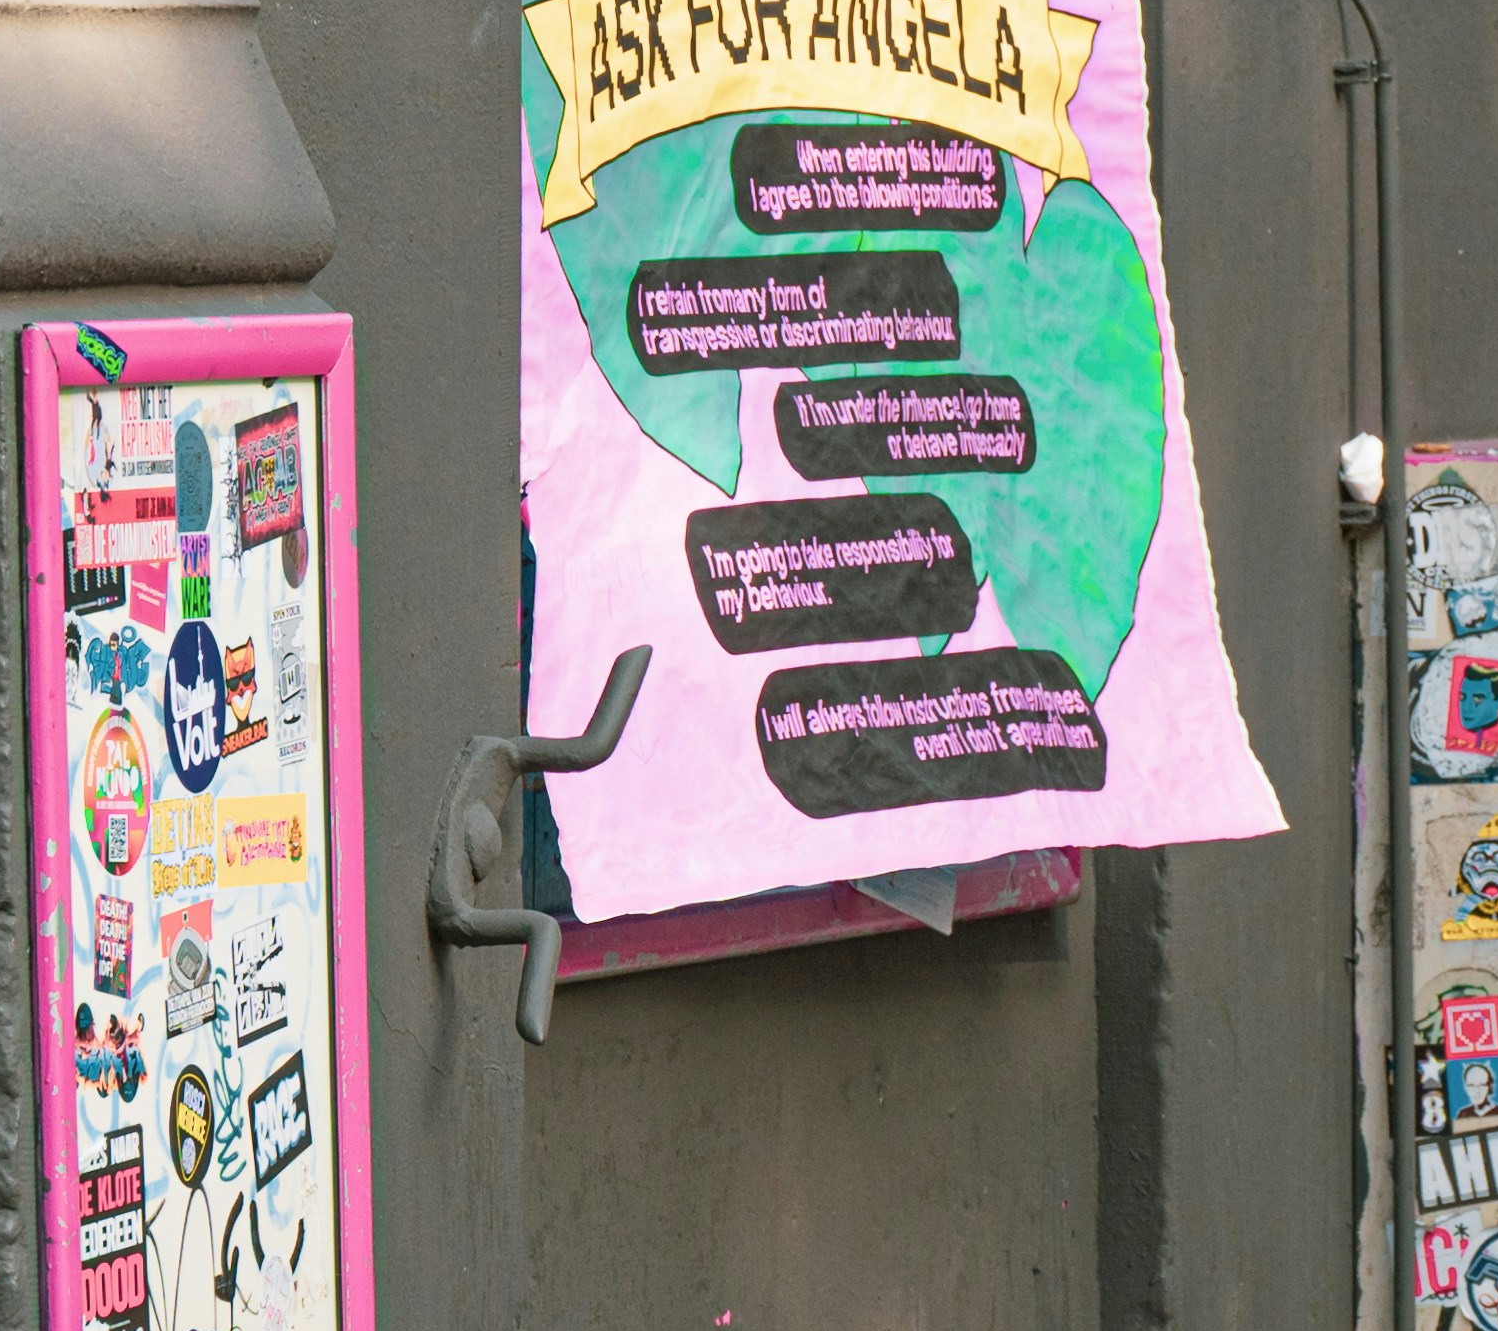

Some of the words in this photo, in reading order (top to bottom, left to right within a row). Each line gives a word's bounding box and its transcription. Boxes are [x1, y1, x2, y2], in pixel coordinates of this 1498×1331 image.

[796, 139, 843, 174] When
[846, 141, 907, 183] entering
[907, 139, 932, 173] this
[931, 140, 996, 182] building,
[750, 178, 758, 213] I
[758, 181, 813, 220] agree
[814, 177, 831, 209] to
[830, 178, 860, 211] the
[858, 176, 922, 216] following
[921, 177, 998, 210] conditions:
[637, 284, 646, 317] I
[646, 283, 698, 317] refrain
[768, 276, 807, 310] form
[808, 276, 827, 310] of
[641, 318, 759, 357] transgressive
[761, 323, 778, 349] or
[780, 308, 896, 350] discriminating
[832, 390, 876, 425] under
[877, 389, 900, 424] the
[965, 395, 983, 429] go
[983, 388, 1021, 422] home
[120, 420, 174, 458] KAPITALISME
[887, 434, 902, 460] or
[902, 426, 958, 459] behave
[94, 523, 107, 565] DE
[702, 544, 736, 578] I'm
[736, 541, 788, 585] going
[786, 538, 804, 572] to
[801, 535, 835, 570] take
[835, 528, 934, 573] responsibility
[931, 528, 955, 560] for
[181, 577, 211, 619] WARE
[715, 587, 746, 624] my
[747, 576, 833, 612] behaviour.
[760, 707, 772, 742] I
[771, 703, 806, 740] will
[806, 697, 866, 737] always
[863, 694, 903, 729] follow
[900, 682, 992, 727] instructions
[175, 708, 220, 770] Volt
[279, 741, 307, 758] RECORDS
[110, 1132, 140, 1166] NAAR
[96, 1166, 141, 1213] KLOTE
[82, 1252, 145, 1323] DOOD
